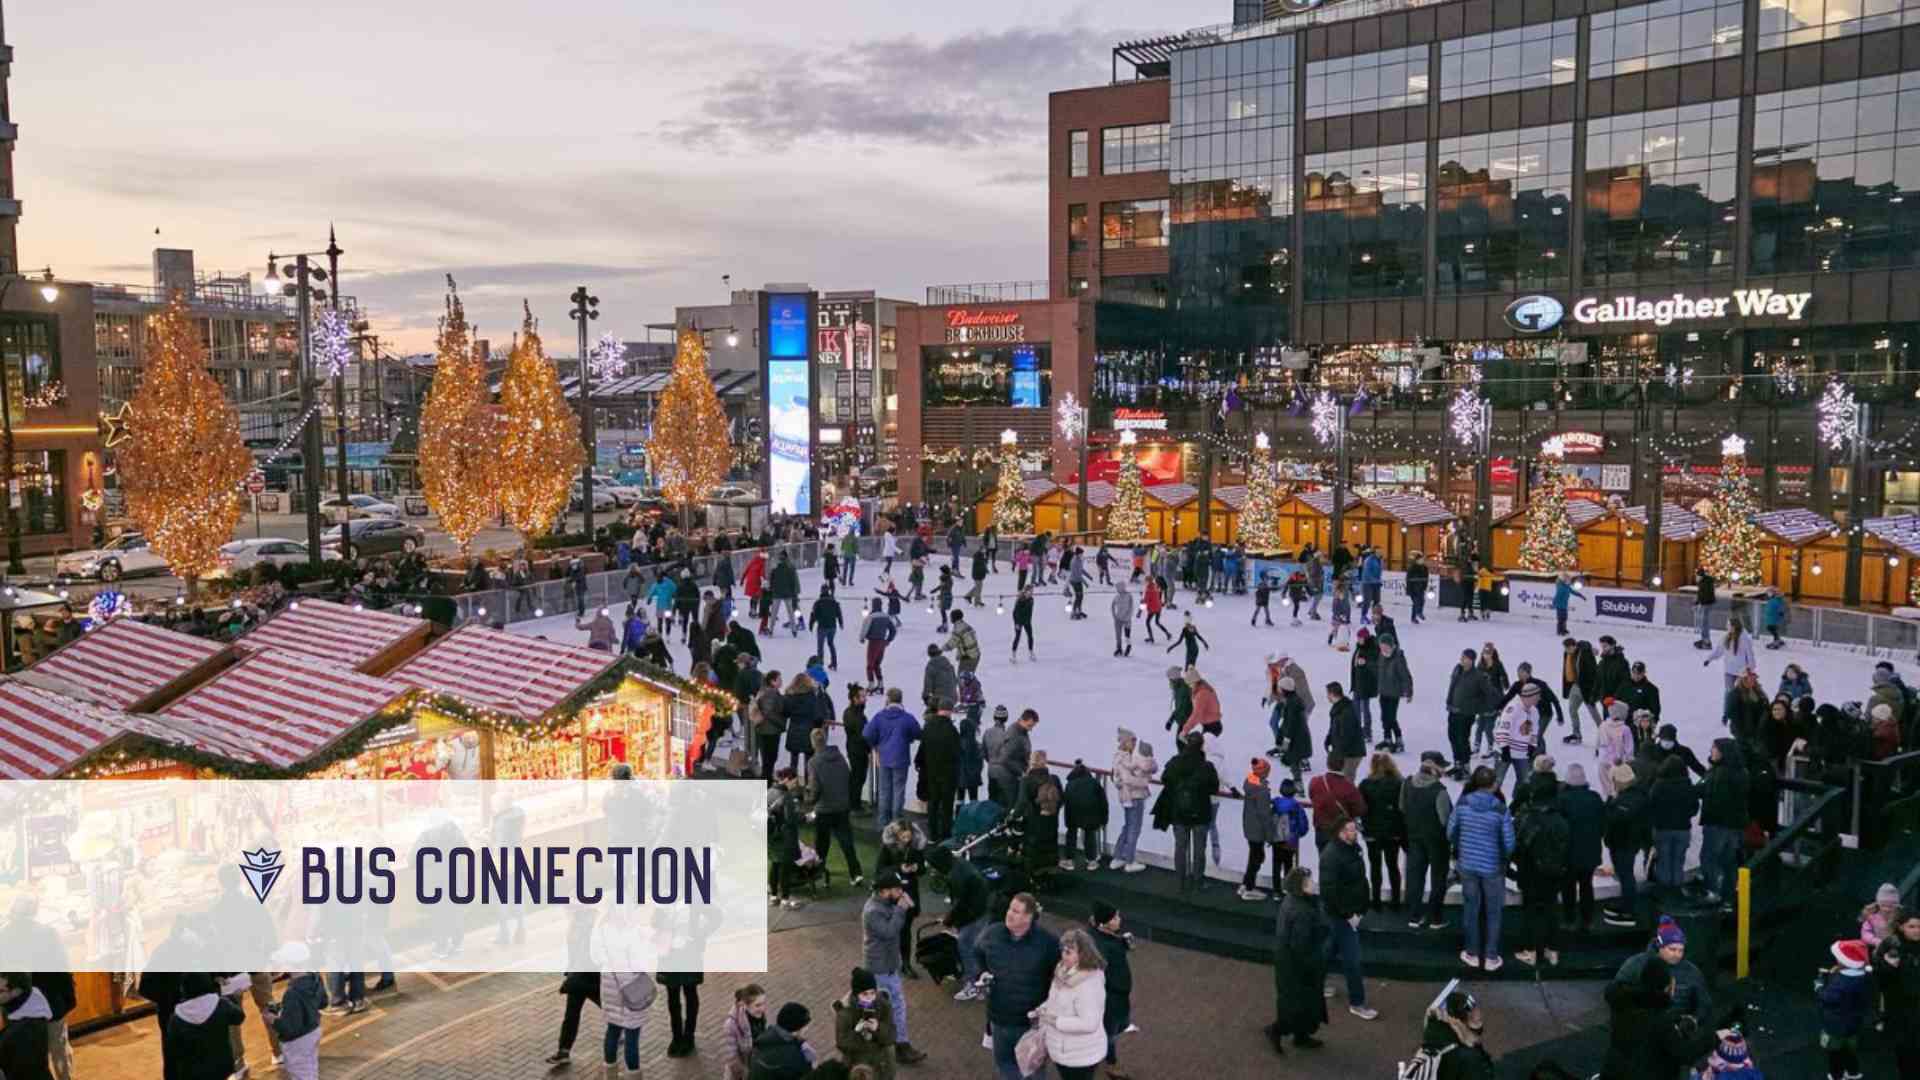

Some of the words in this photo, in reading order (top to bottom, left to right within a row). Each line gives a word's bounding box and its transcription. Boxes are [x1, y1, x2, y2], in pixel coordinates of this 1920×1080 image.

[1573, 293, 1730, 326] Gallagher
[1733, 288, 1812, 320] Way
[946, 309, 1019, 326] Budweiser
[944, 324, 1025, 344] BRCKHOUSE
[1555, 431, 1604, 449] ARQUEE
[1601, 599, 1649, 615] StubHub
